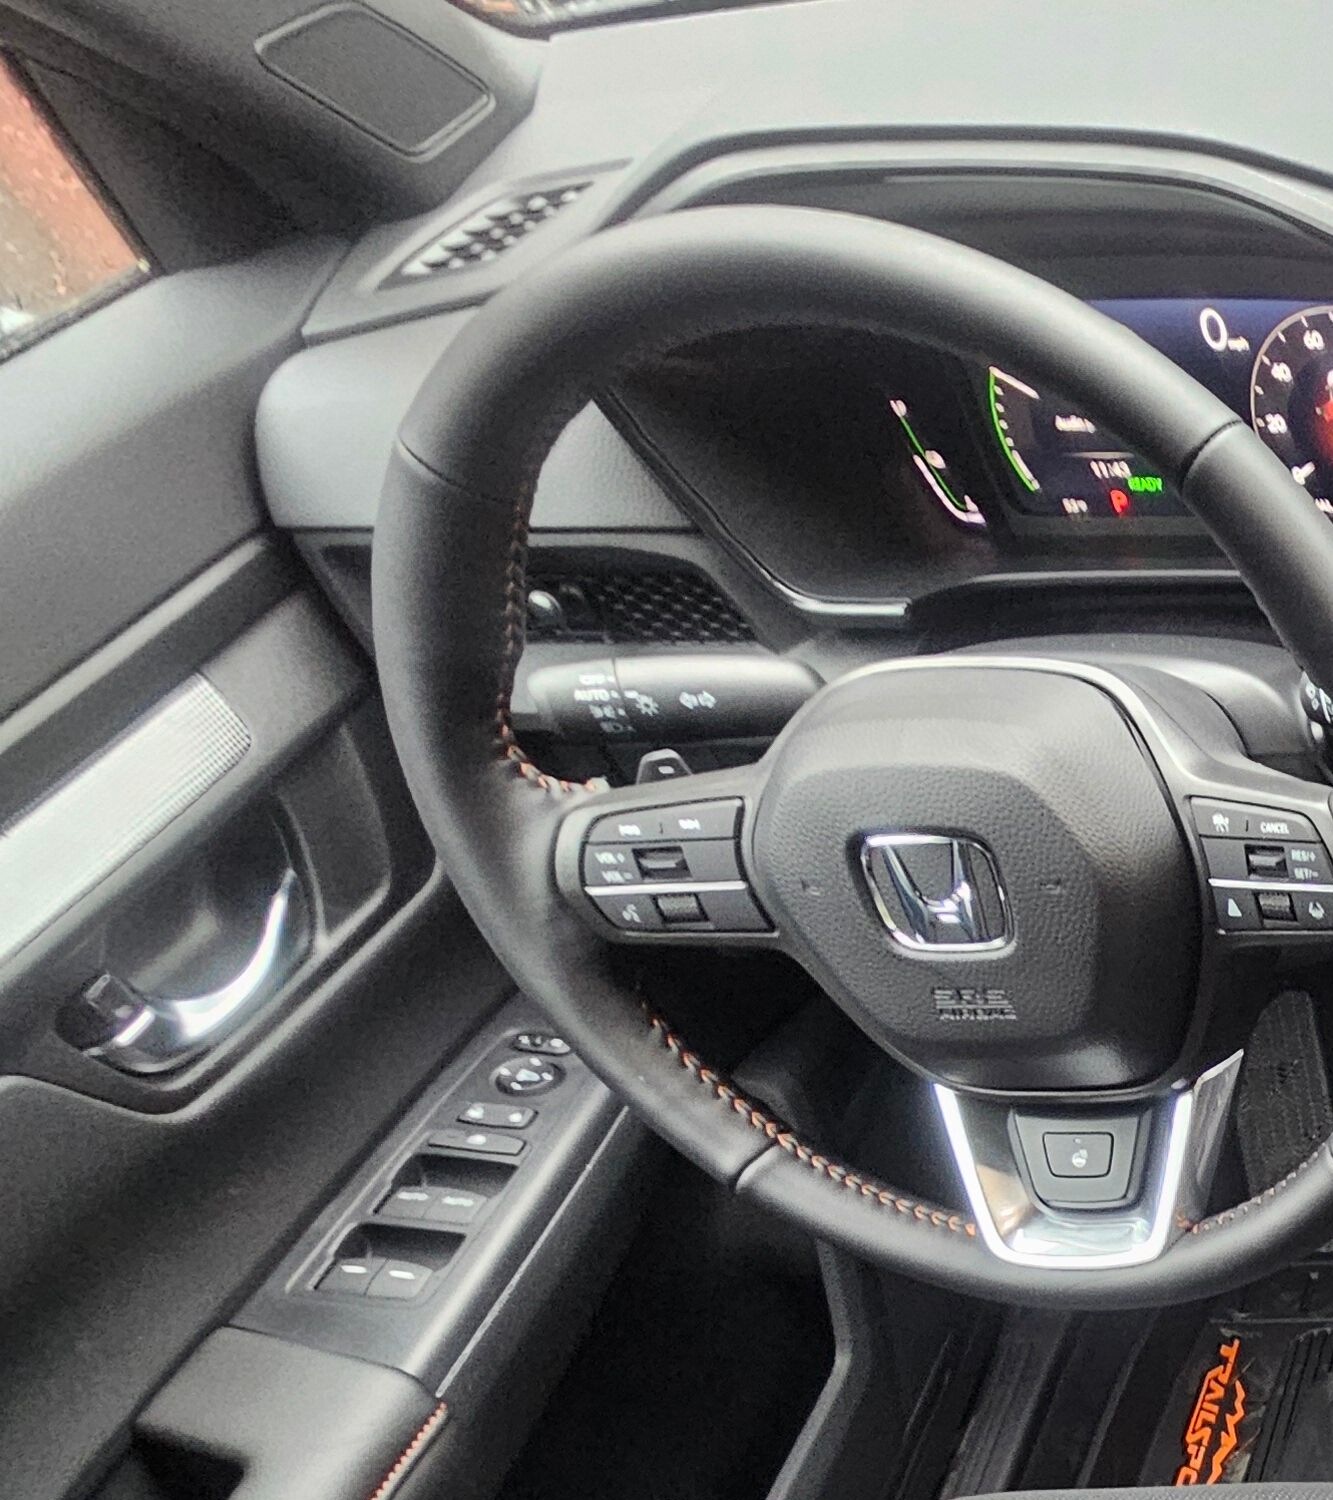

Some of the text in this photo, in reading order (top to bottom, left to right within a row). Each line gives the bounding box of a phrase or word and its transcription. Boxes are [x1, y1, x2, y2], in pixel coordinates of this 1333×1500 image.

[1200, 307, 1228, 352] 0
[1303, 329, 1325, 351] 60
[1110, 489, 1129, 514] P
[573, 689, 610, 701] AUTO
[1260, 821, 1290, 835] CANCEL
